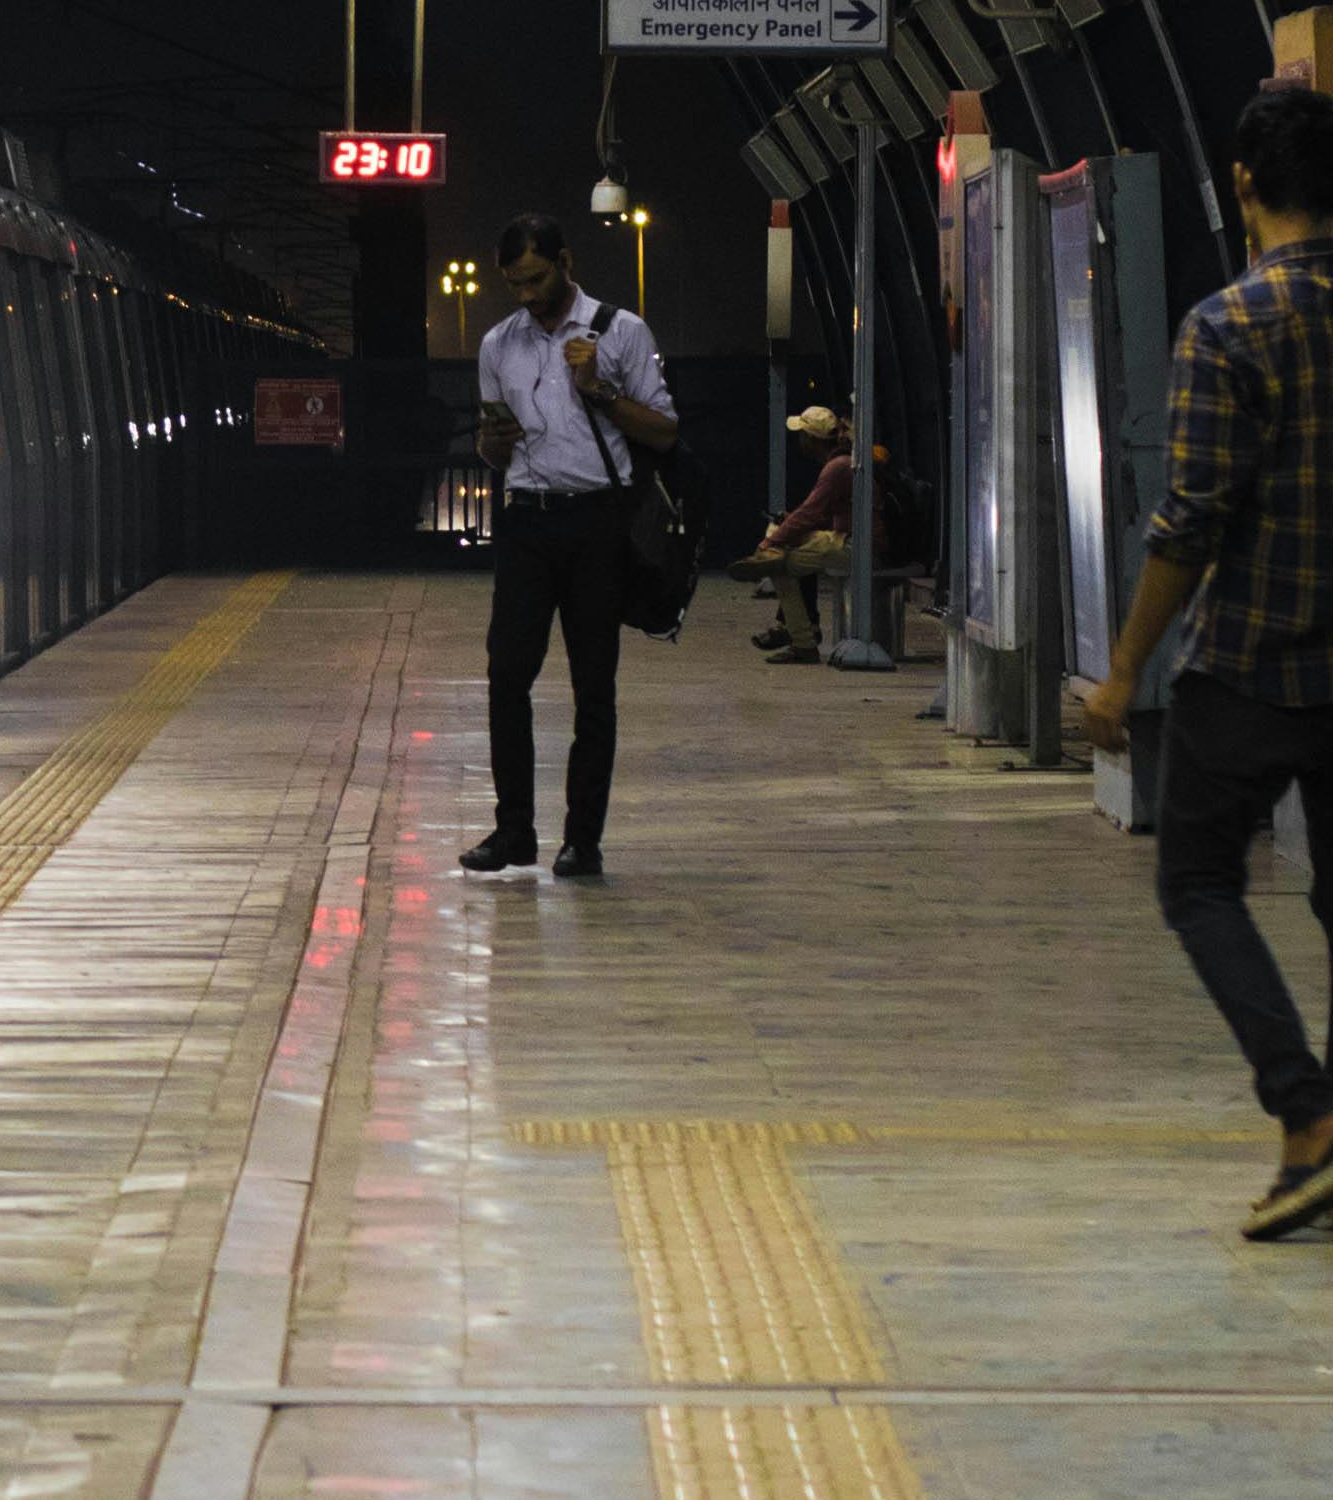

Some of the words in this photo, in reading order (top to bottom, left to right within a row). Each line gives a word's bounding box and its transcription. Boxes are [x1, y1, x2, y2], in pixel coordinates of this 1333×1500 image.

[641, 18, 759, 40] Emergency
[765, 20, 822, 37] Panel
[334, 141, 431, 176] 23:10
